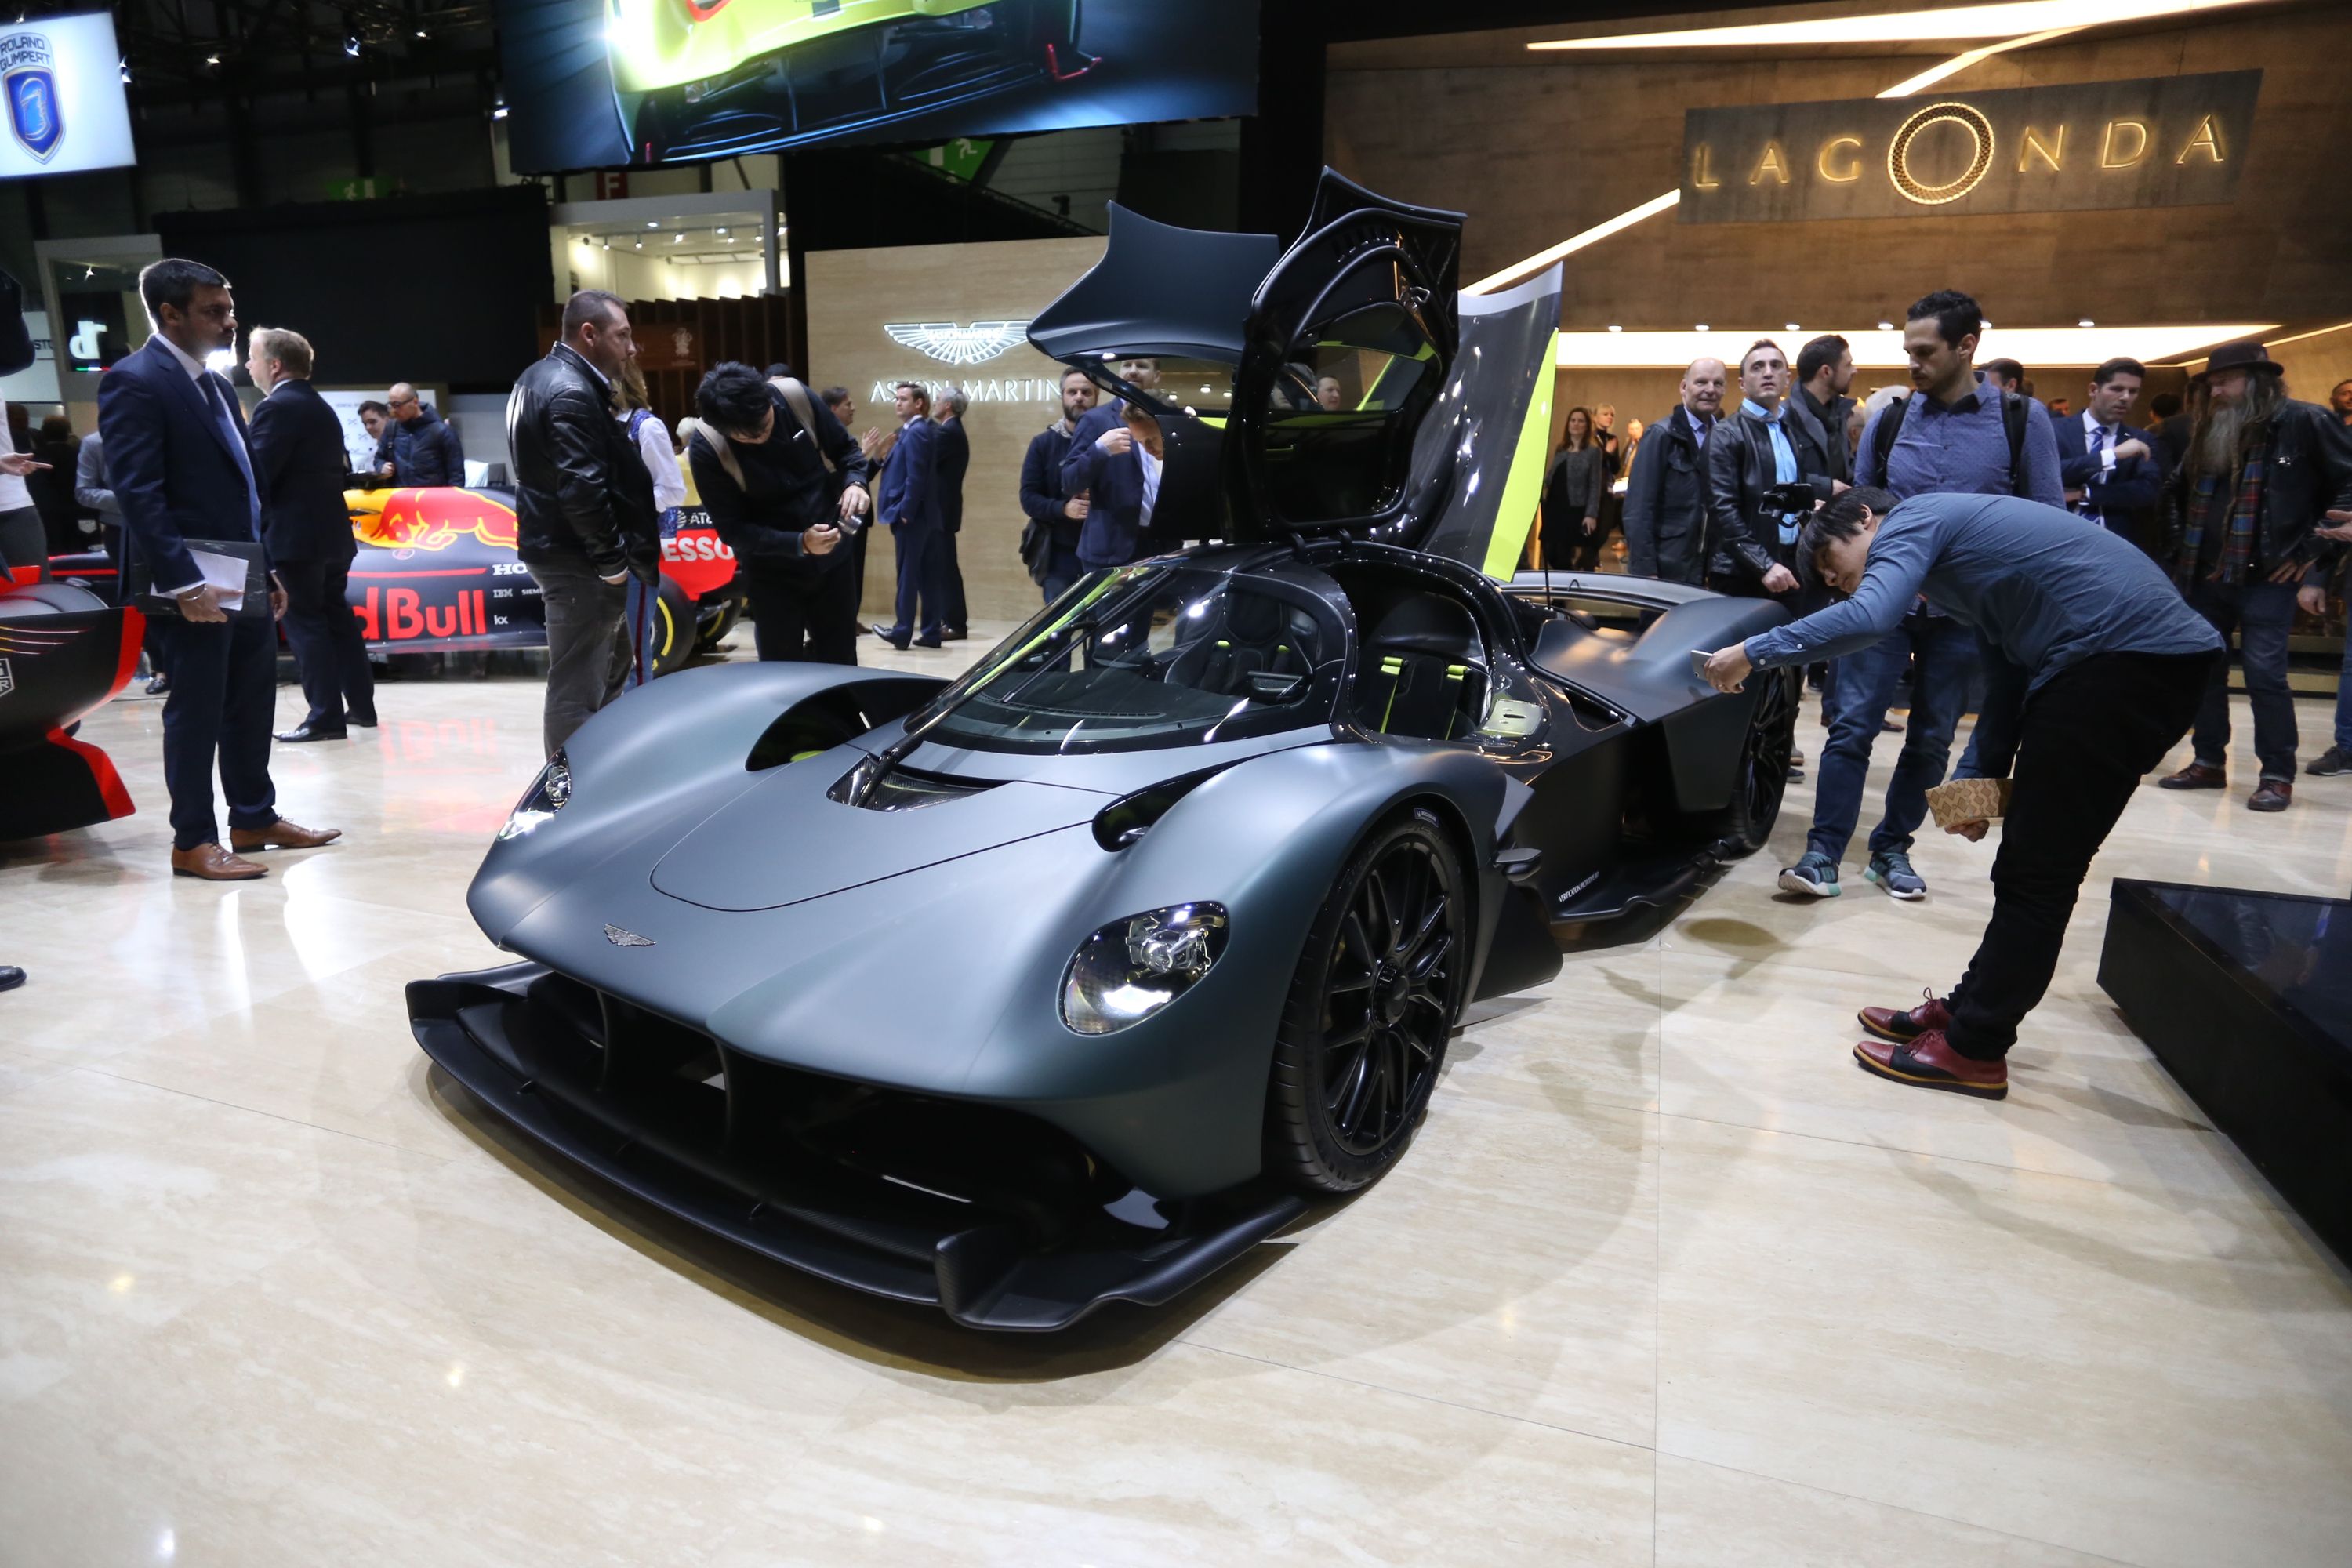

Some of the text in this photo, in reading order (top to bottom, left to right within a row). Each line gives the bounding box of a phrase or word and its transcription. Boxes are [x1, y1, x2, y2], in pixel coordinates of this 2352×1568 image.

[0, 36, 45, 56] ROLAND
[0, 50, 50, 71] GUMPERT
[1693, 101, 2225, 205] LAGONDA
[870, 379, 1062, 402] ASN MARTIN
[660, 536, 735, 561] ESSO
[493, 588, 513, 598] IBM
[387, 588, 487, 640] Bull
